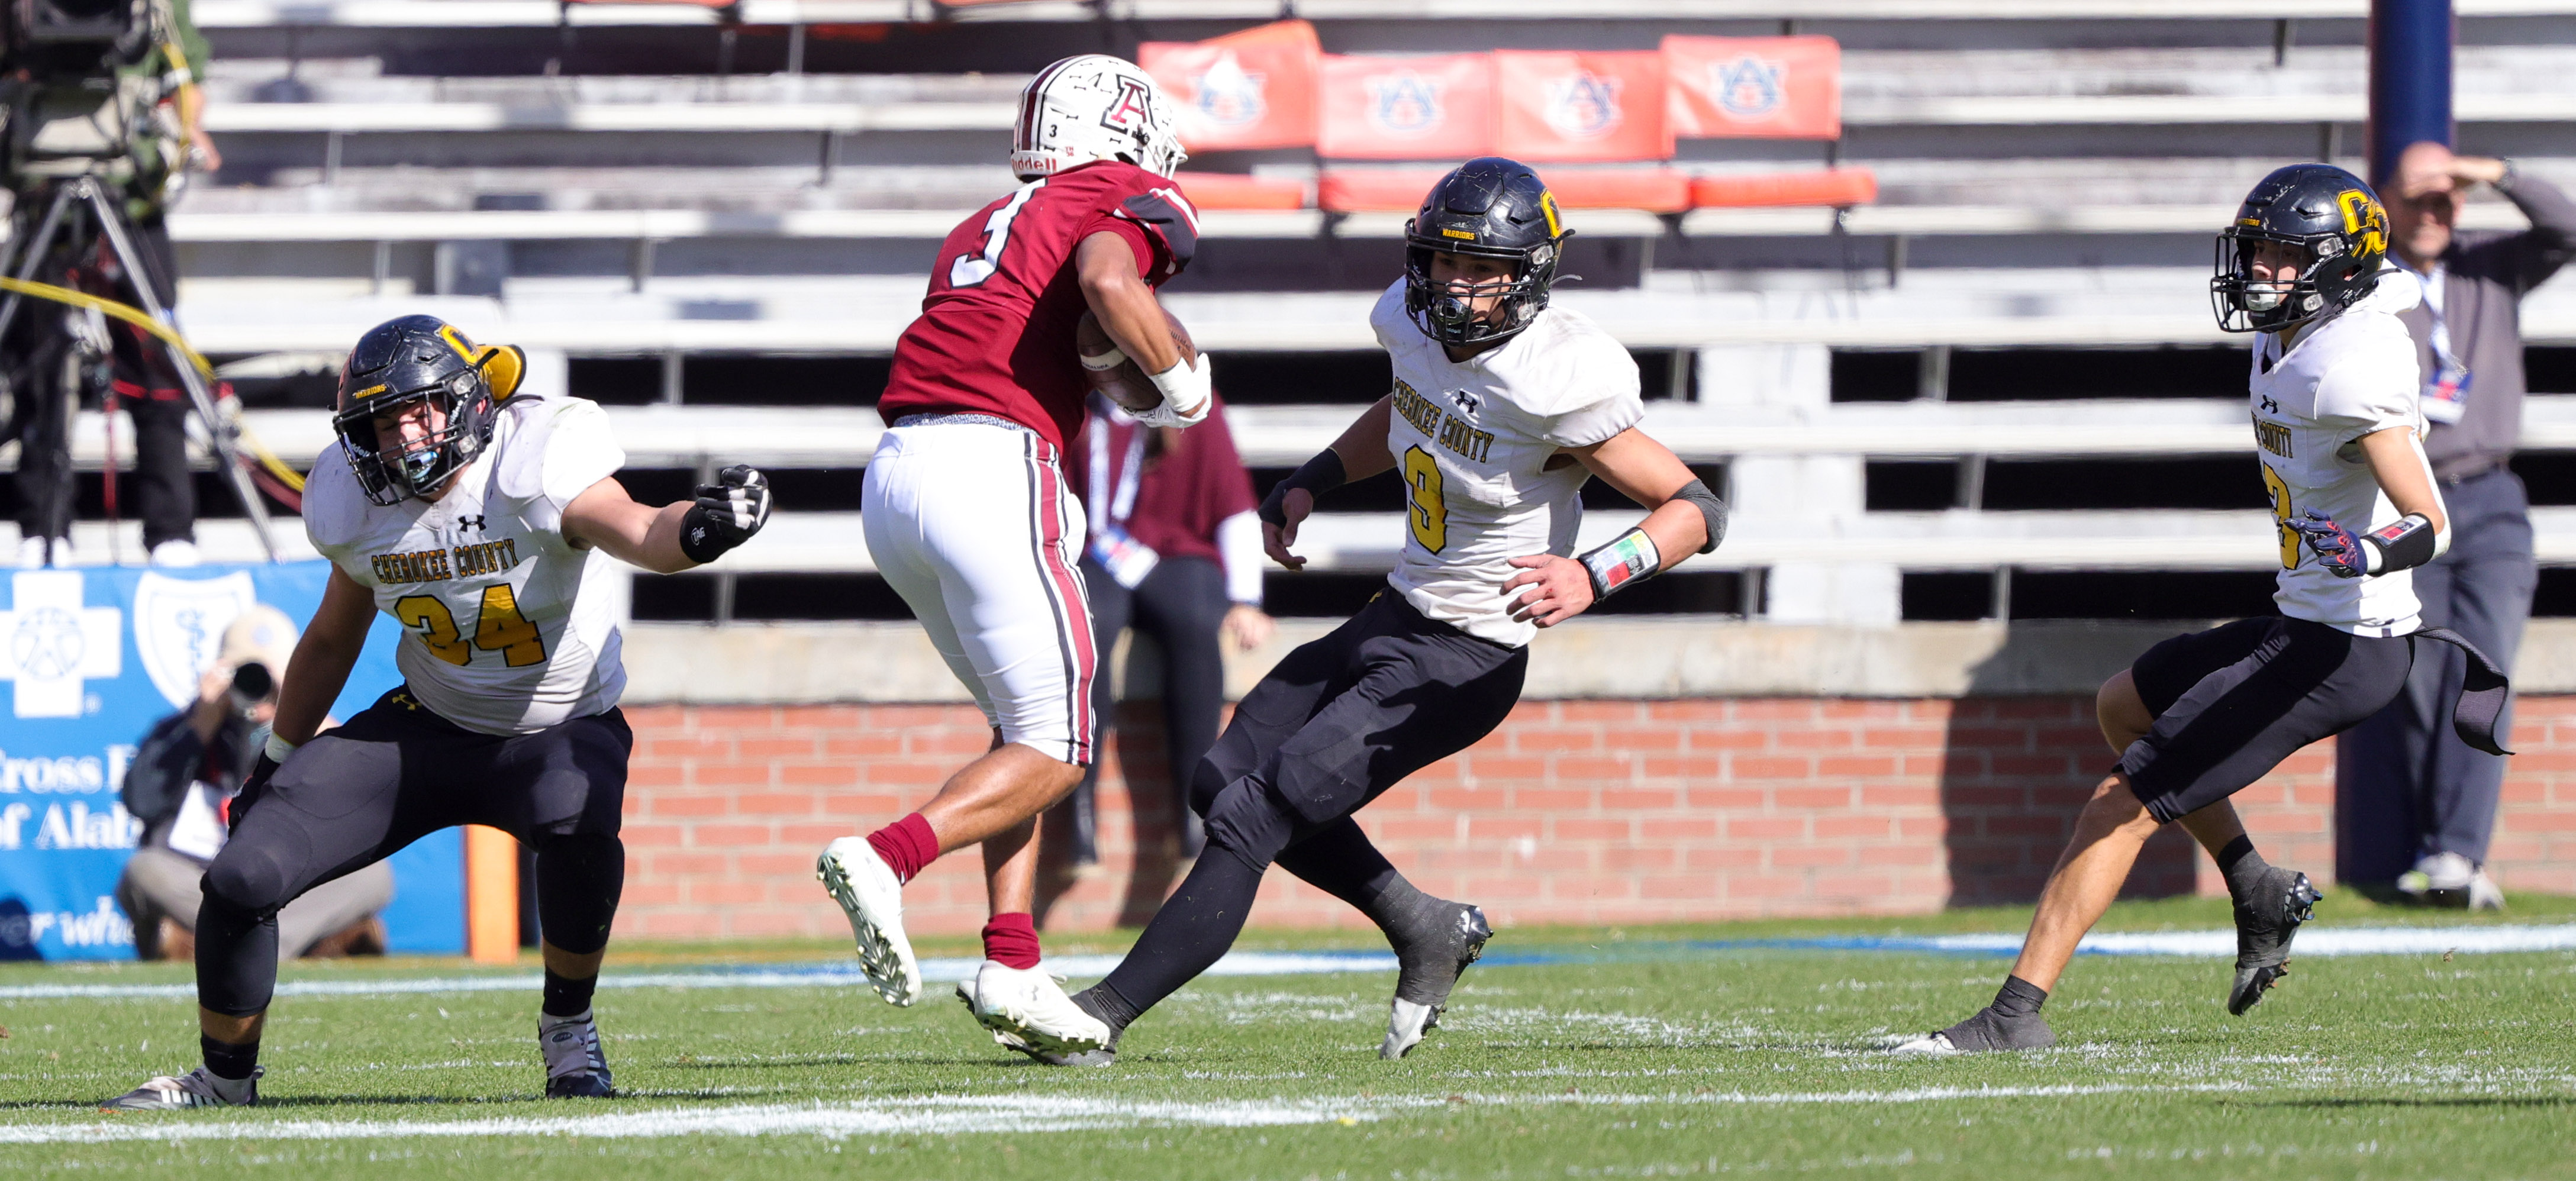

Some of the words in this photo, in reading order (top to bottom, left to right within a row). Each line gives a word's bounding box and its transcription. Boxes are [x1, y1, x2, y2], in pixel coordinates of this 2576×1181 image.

[1049, 124, 1058, 138] 3
[1100, 73, 1158, 135] A
[948, 178, 1050, 290] 3
[1442, 228, 1475, 240] WARRIORS
[1392, 376, 1442, 438] CHEROKEE
[1439, 413, 1495, 463] COUNTY
[1404, 443, 1449, 556] 9
[371, 549, 453, 584] CHEROKEE
[454, 538, 519, 577] COUNTY
[394, 582, 547, 668] 34
[0, 750, 103, 793] ross
[0, 802, 31, 850] f
[33, 801, 146, 850] Alab
